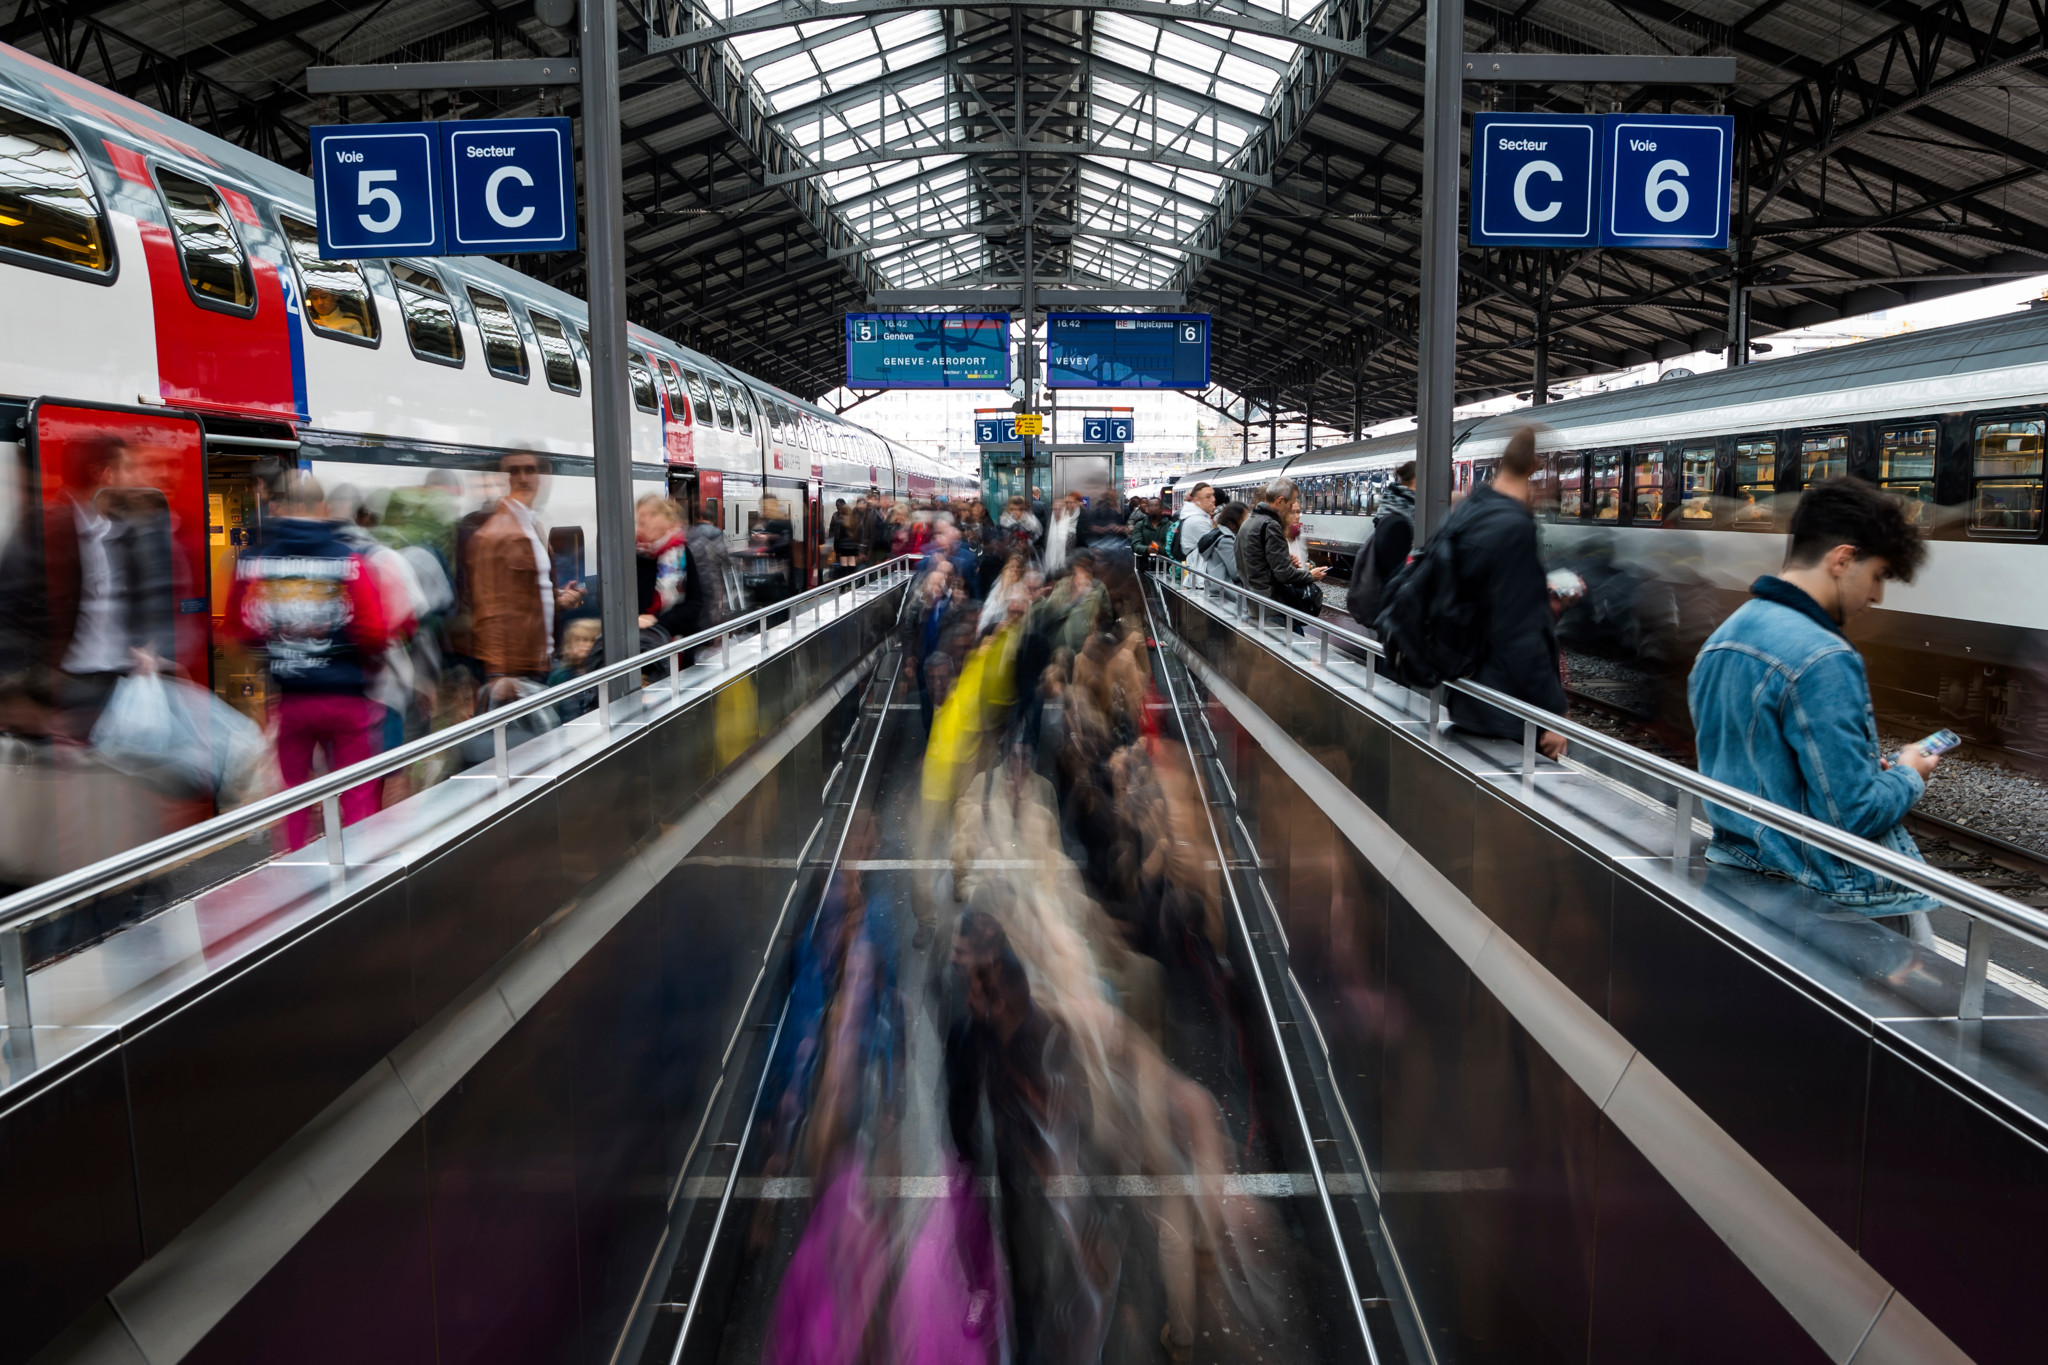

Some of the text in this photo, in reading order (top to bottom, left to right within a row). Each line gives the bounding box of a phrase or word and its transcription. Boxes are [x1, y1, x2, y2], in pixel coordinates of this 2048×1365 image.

[1499, 138, 1548, 151] Secteur
[1629, 139, 1657, 152] Voie
[336, 151, 364, 163] Voie
[466, 145, 516, 158] Secteur
[485, 166, 536, 228] C
[1513, 160, 1563, 222] C
[1644, 159, 1690, 223] 6
[357, 169, 402, 233] 5
[282, 273, 299, 315] 2
[1057, 320, 1081, 328] 16.42
[1117, 320, 1174, 329] RE RegioExpress
[860, 326, 872, 341] 5
[883, 332, 914, 341] Genève
[1185, 327, 1196, 341] 6
[1056, 357, 1090, 365] VEVEY
[983, 427, 992, 440] 5
[1008, 427, 1018, 440] C
[1091, 426, 1101, 439] C
[1117, 426, 1126, 439] 6
